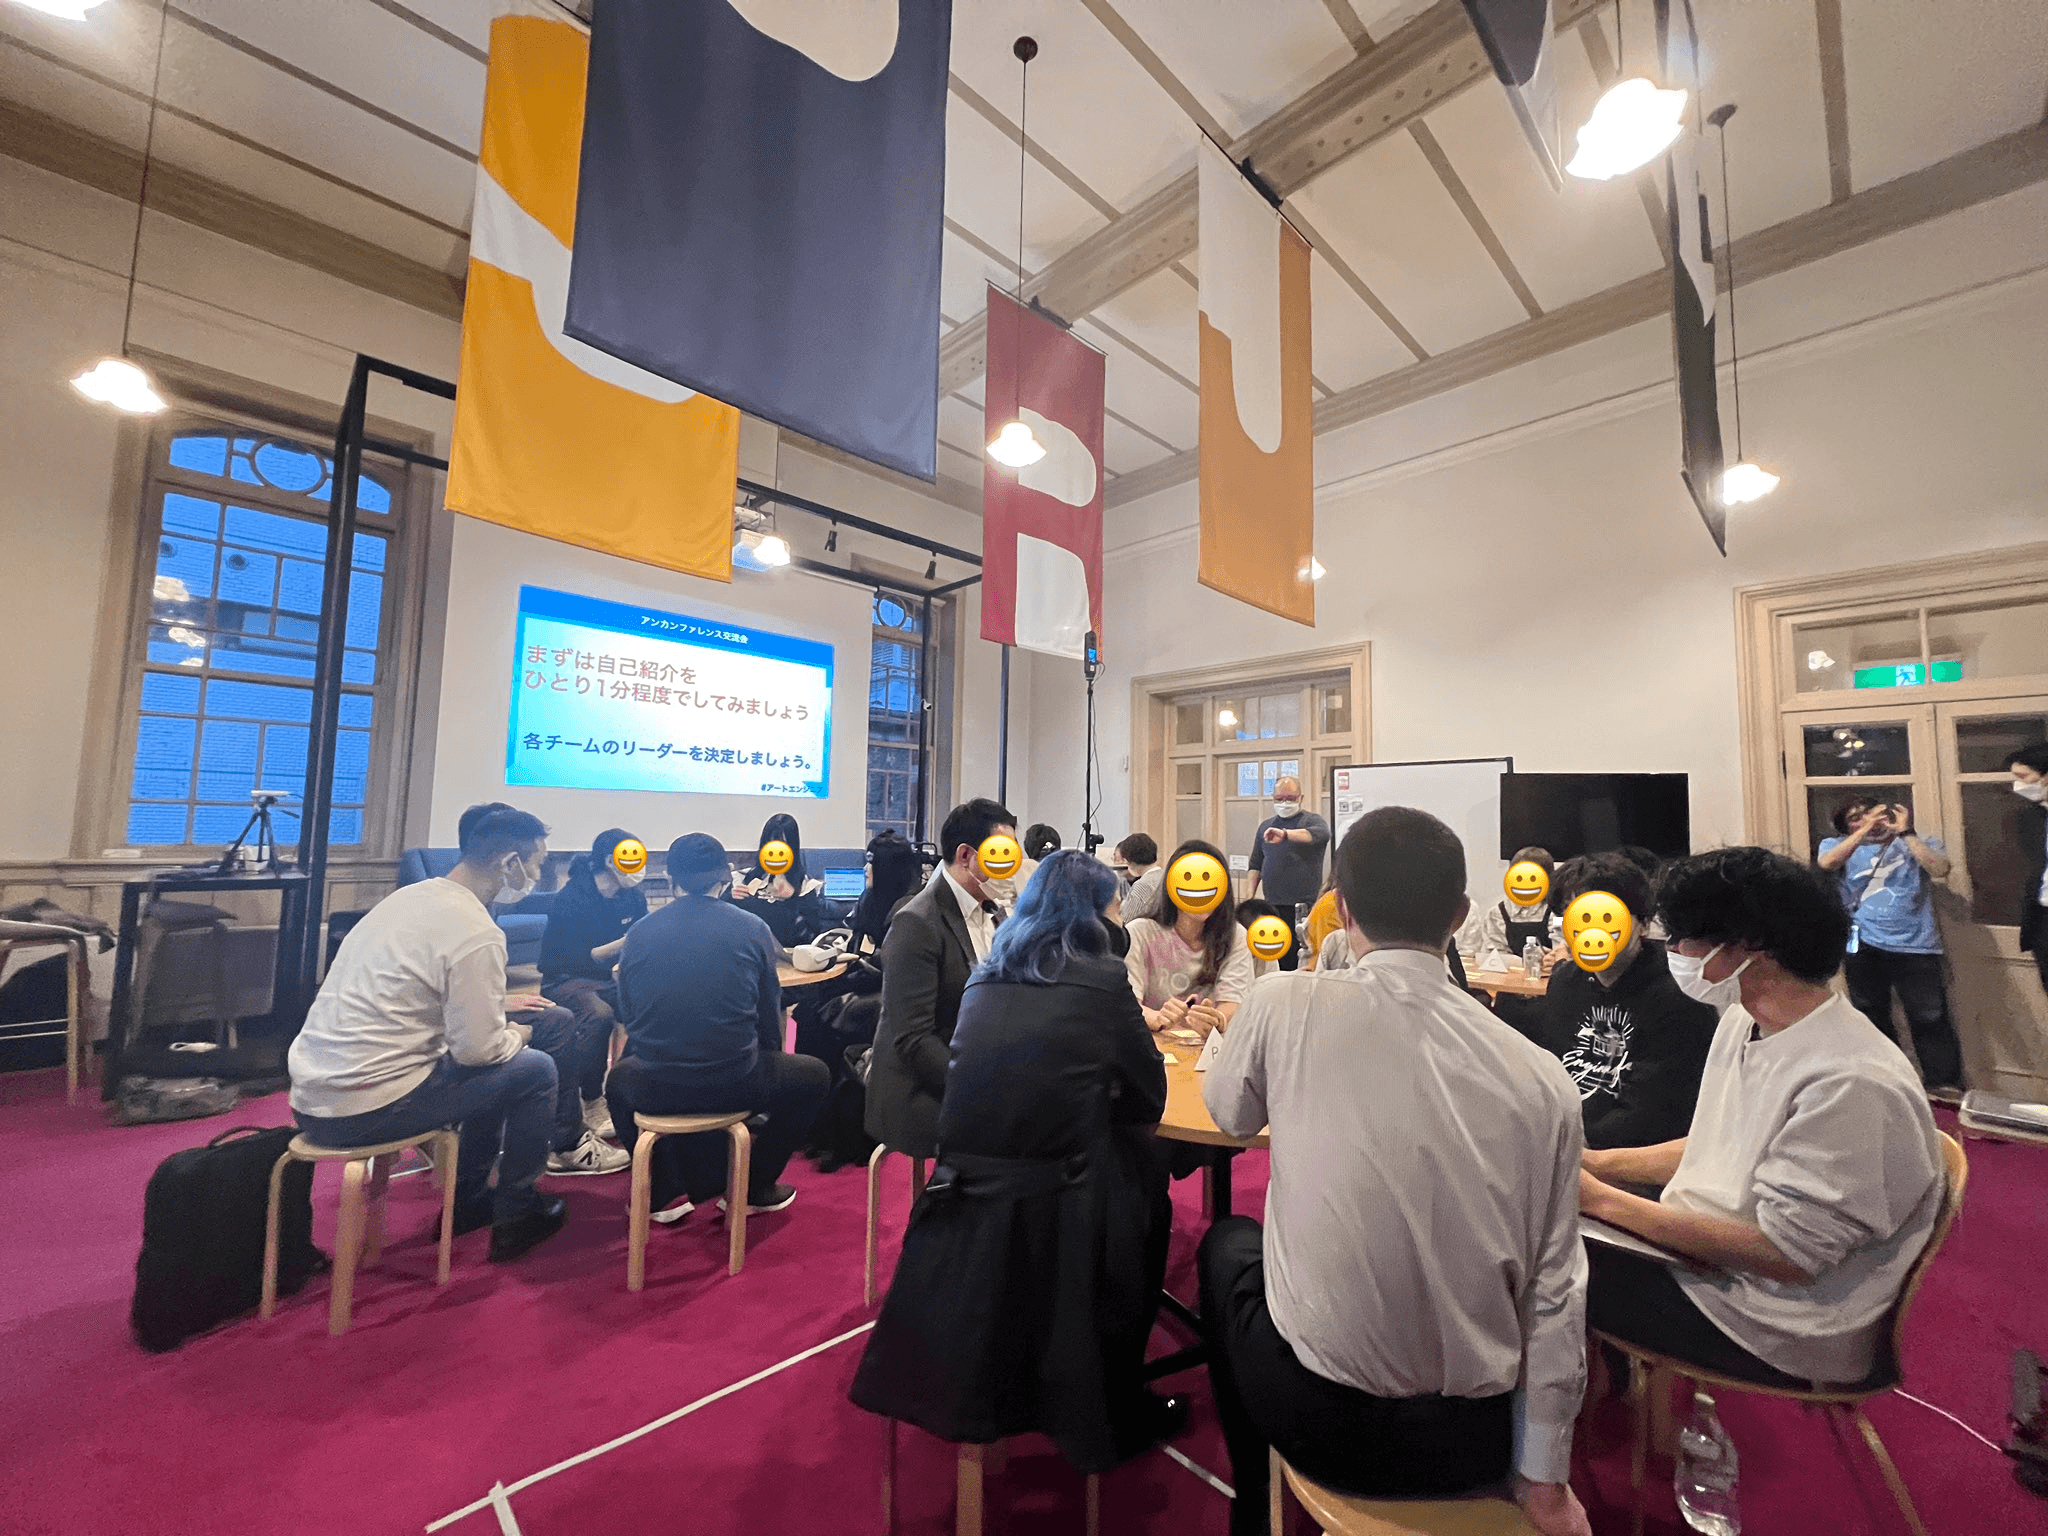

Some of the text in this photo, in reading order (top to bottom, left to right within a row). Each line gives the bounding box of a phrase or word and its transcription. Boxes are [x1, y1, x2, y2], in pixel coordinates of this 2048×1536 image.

[640, 615, 749, 645] アンカンファレンス交流会
[526, 644, 698, 686] まずは自己紹介を
[523, 669, 810, 722] ひとり1分程度でしてみましょう
[522, 732, 812, 771] 各チームのリーダーを決定しましょう。
[760, 783, 824, 794] #アートエンジニア
